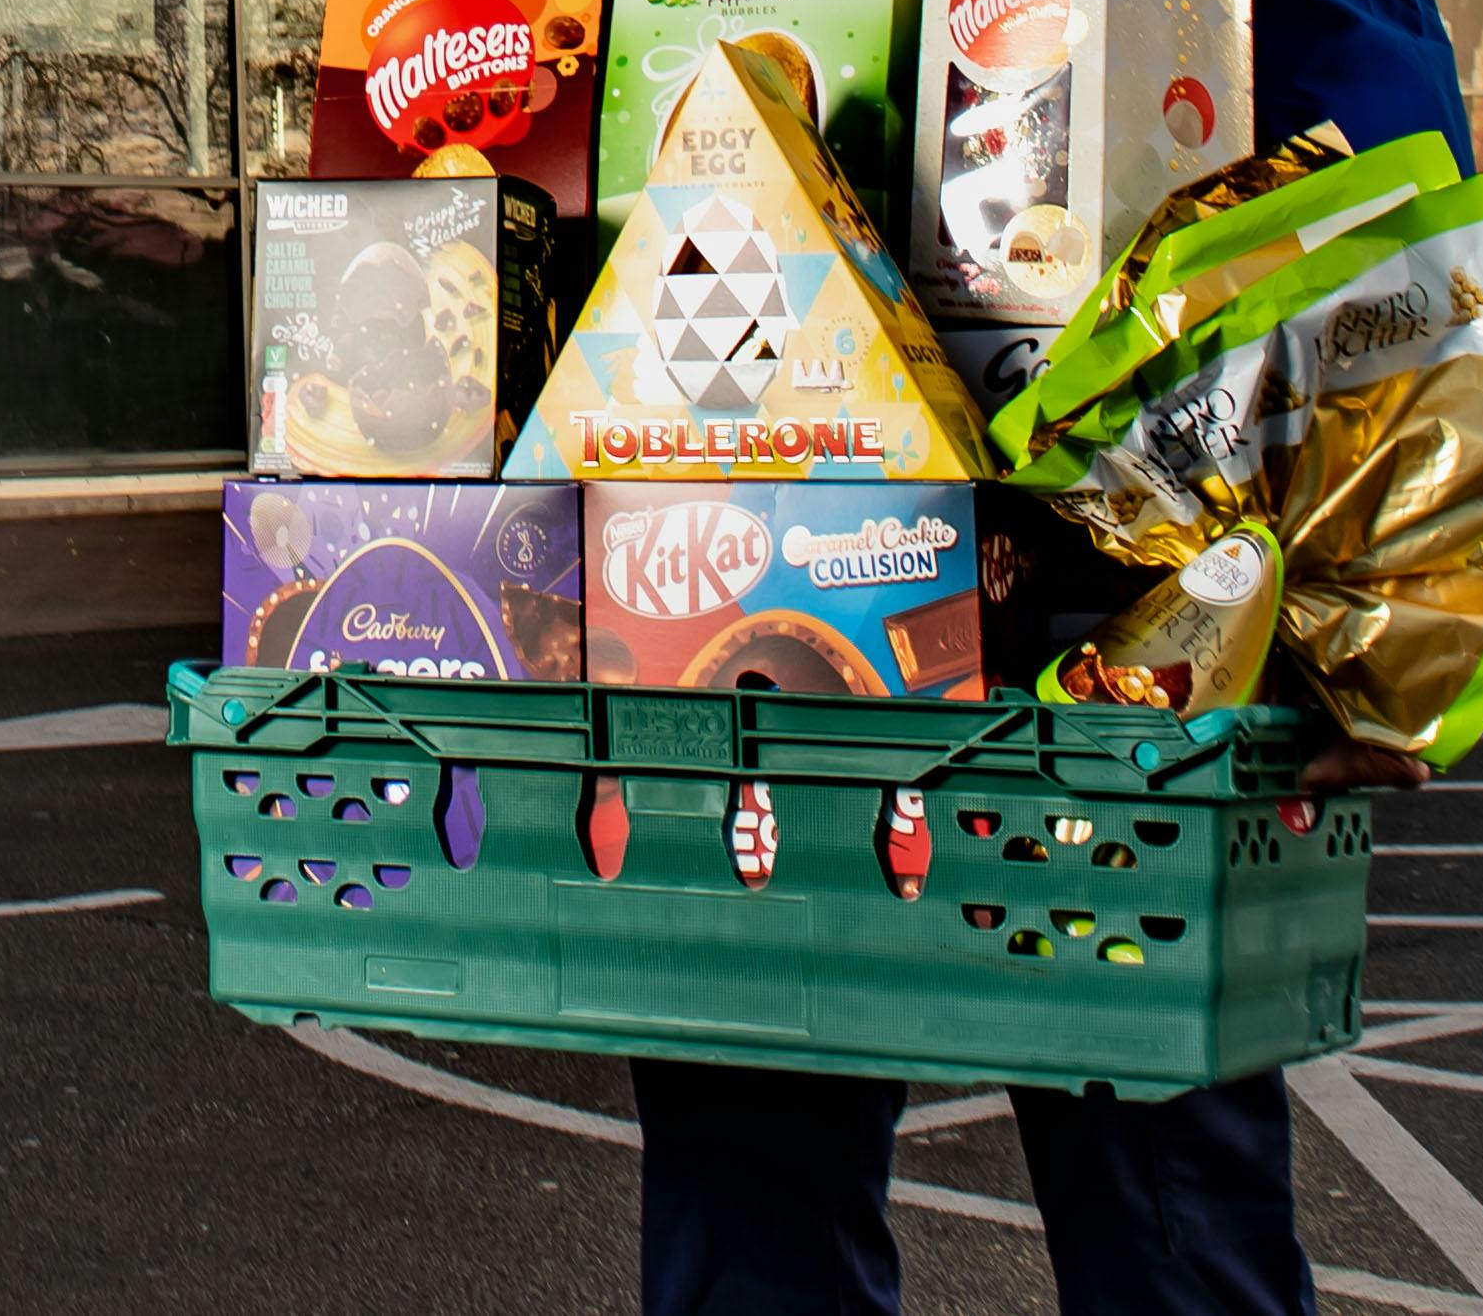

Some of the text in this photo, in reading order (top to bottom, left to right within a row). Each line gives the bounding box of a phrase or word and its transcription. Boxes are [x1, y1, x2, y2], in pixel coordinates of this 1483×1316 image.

[721, 6, 778, 17] BUBBLES
[365, 23, 531, 130] Maltesers
[446, 55, 529, 90] BUTTONS
[682, 127, 756, 152] EDGY
[691, 152, 747, 176] EGG
[265, 192, 348, 218] WICKED
[265, 242, 307, 257] SALTED
[265, 258, 316, 275] CARAMEL
[265, 275, 313, 292] FLAVOUR
[264, 292, 317, 308] CHOC EGG
[835, 328, 856, 355] 6
[570, 410, 885, 468] TOBLERONE
[879, 519, 951, 550] Cookie
[626, 504, 761, 616] KitKat
[814, 550, 933, 582] COLLISION
[342, 603, 446, 650] Cadbury
[1180, 630, 1232, 692] EGG
